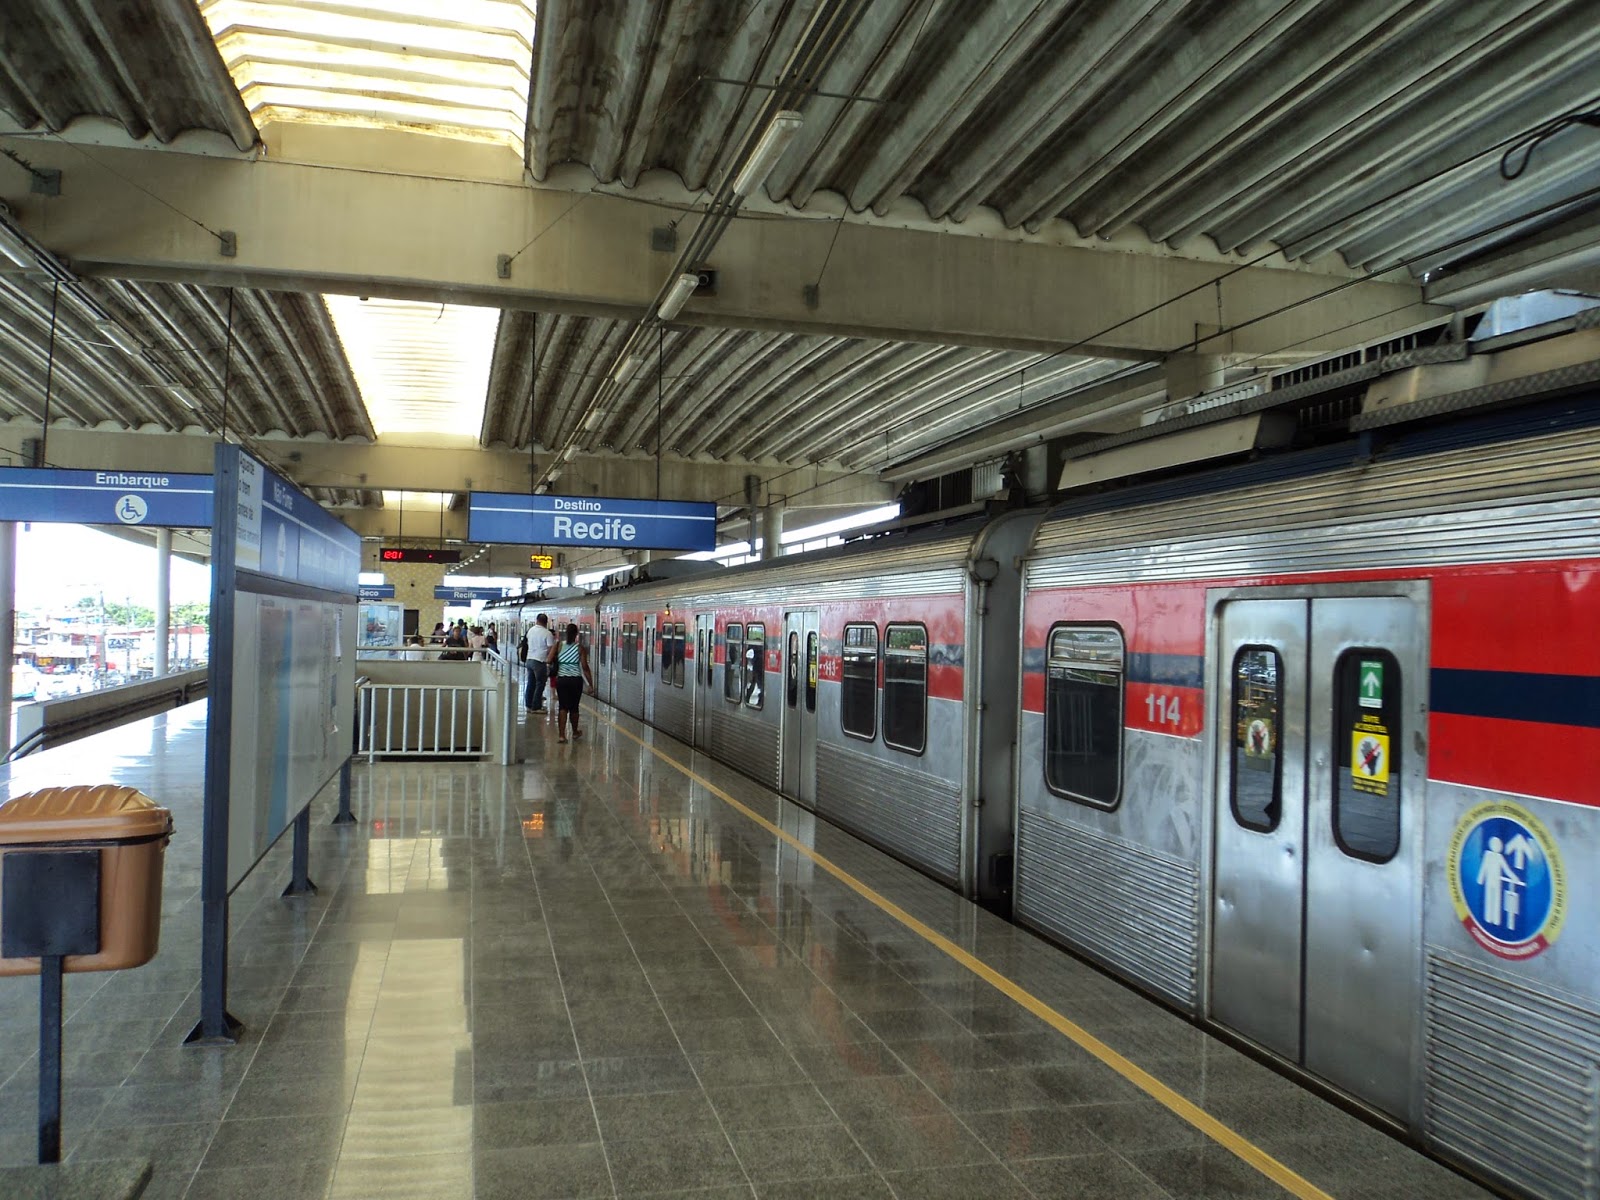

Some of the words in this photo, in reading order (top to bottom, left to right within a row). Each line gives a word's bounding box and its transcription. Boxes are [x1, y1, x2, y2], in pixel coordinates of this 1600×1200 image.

[96, 472, 169, 488] Embarque
[554, 499, 601, 511] Destino
[554, 516, 636, 541] Recife
[384, 551, 403, 559] 12:01
[1145, 694, 1180, 726] 114
